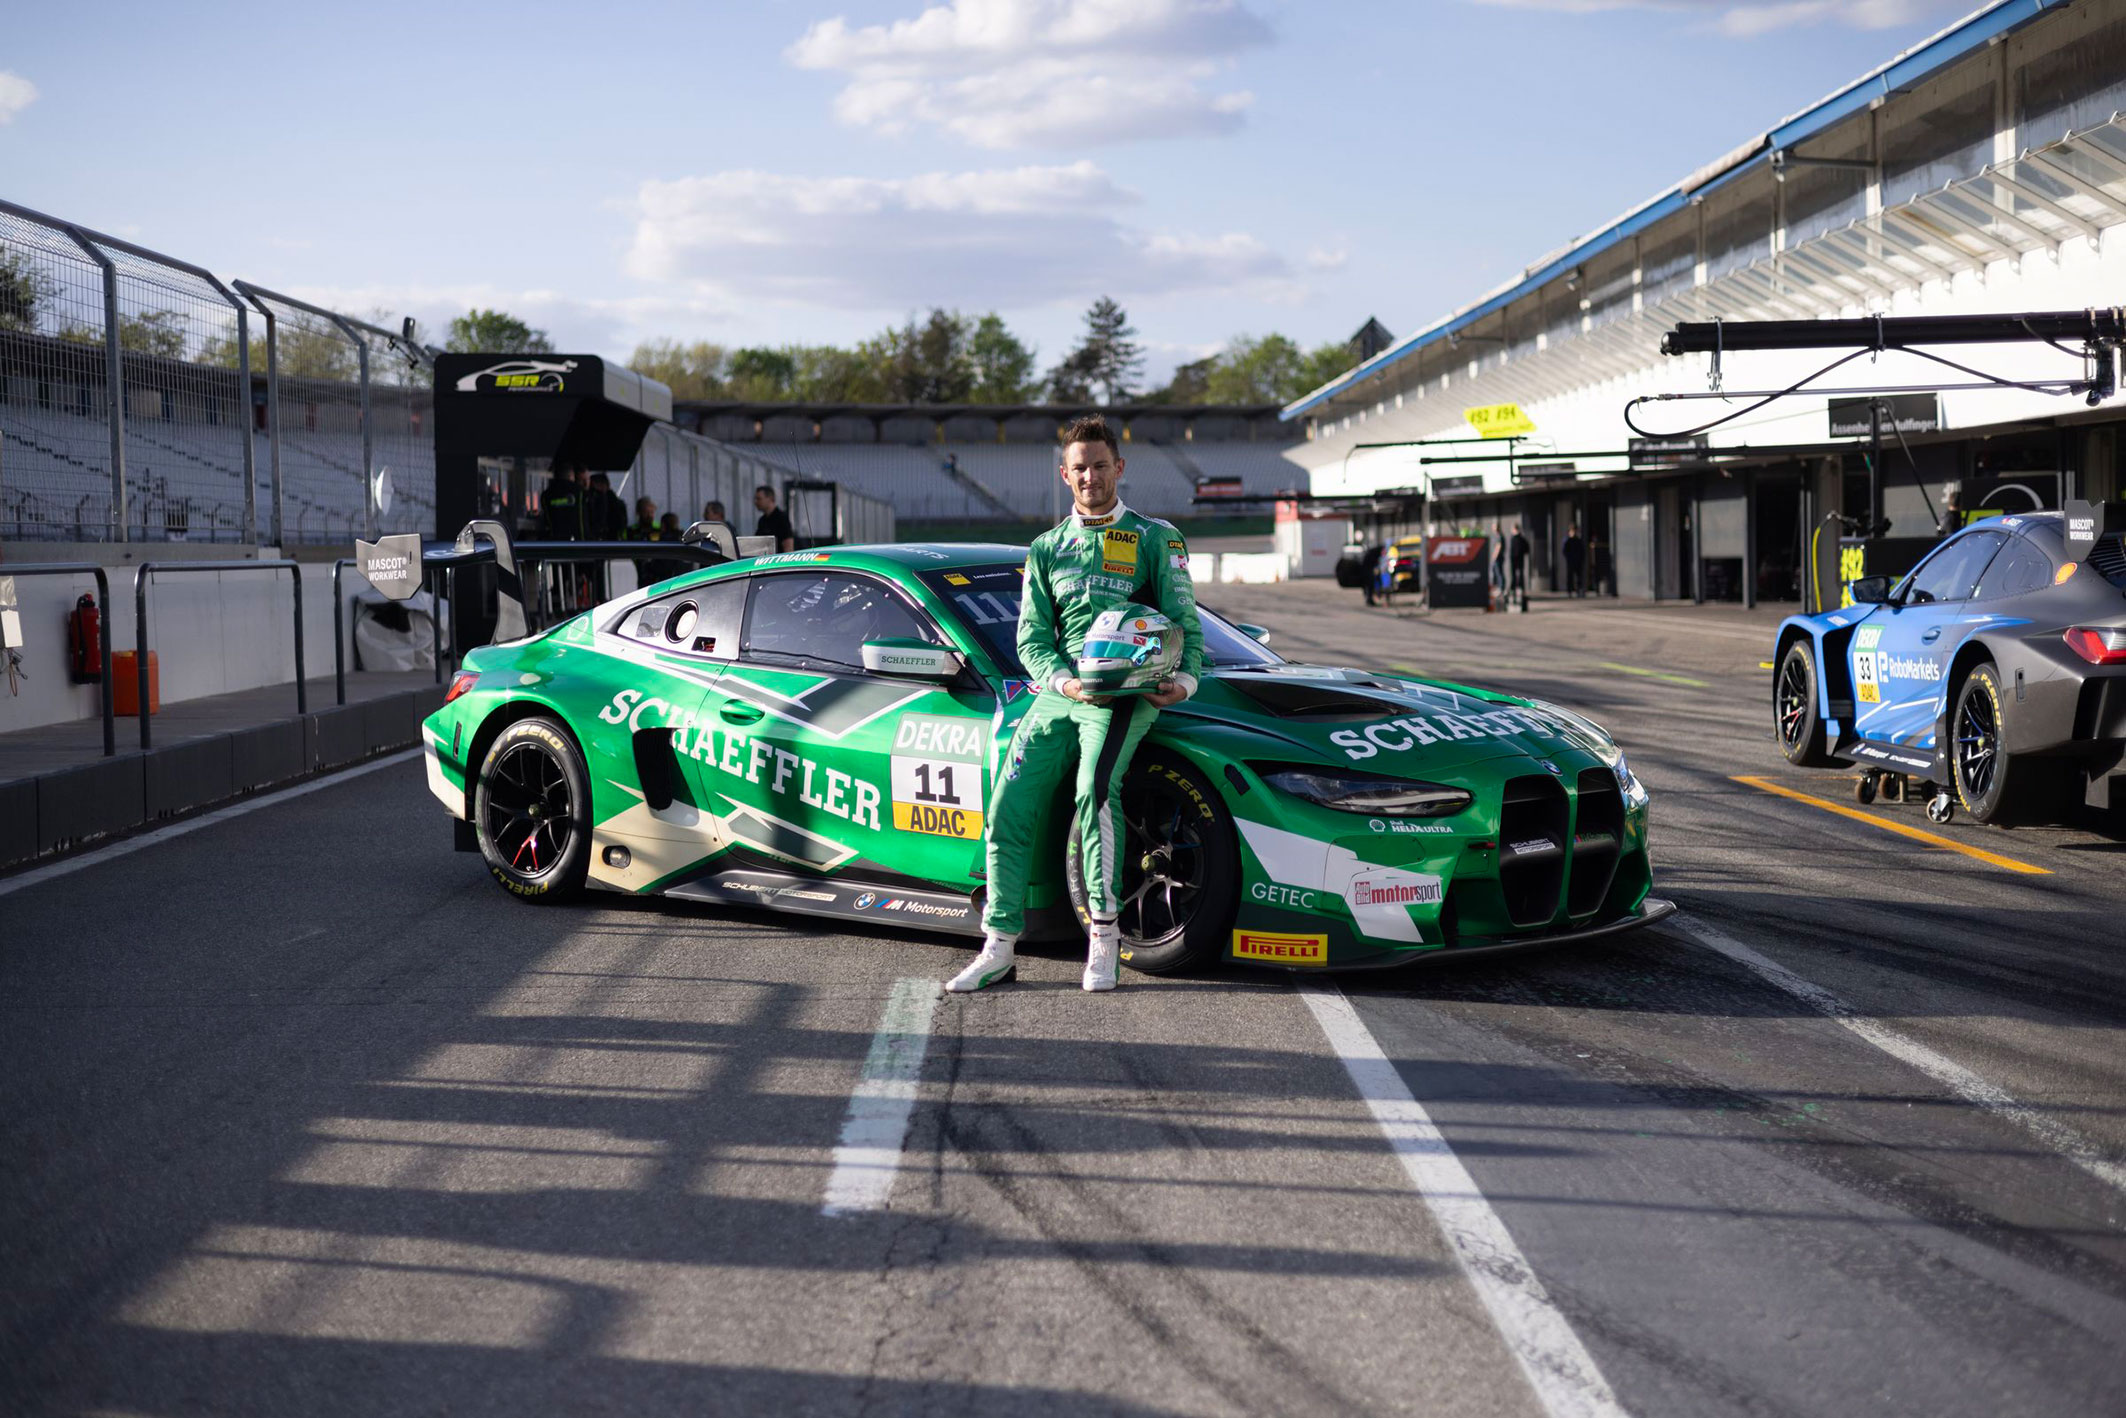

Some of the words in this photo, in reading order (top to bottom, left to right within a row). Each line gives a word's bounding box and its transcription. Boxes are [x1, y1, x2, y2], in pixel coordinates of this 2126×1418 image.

[495, 375, 540, 387] SSR
[1106, 531, 1137, 544] ADAC
[754, 552, 819, 566] WITTMANN
[1432, 541, 1471, 560] ABT
[368, 570, 407, 582] WORKWEAR
[954, 591, 1020, 625] 11
[881, 655, 936, 667] SCHAEFFLER
[1860, 656, 1872, 681] 33
[1889, 655, 1940, 681] RoboMarkets
[896, 719, 982, 757] DEKRA
[599, 689, 881, 832] SCHAEFFLER
[914, 763, 961, 805] 11
[910, 805, 966, 837] ADAC
[722, 882, 779, 896] SCHUBERT
[779, 889, 836, 901] MOTORSPORT
[1252, 882, 1315, 908] GETEC
[1371, 882, 1441, 904] motorsport
[904, 901, 969, 918] Motorsport
[1240, 935, 1319, 957] PIRELLI
